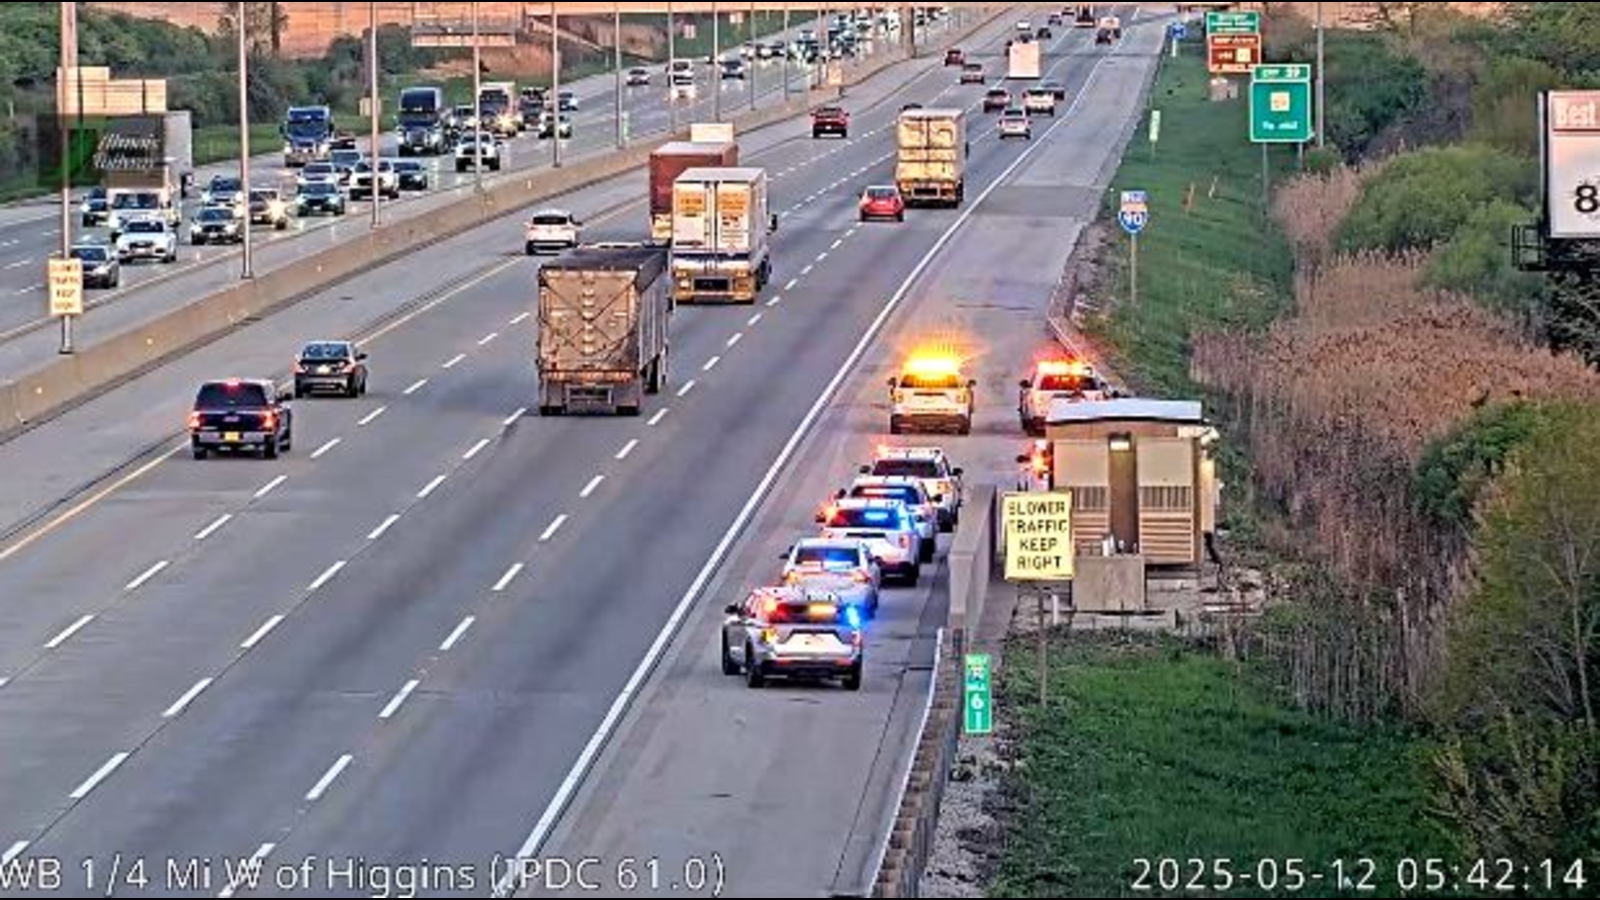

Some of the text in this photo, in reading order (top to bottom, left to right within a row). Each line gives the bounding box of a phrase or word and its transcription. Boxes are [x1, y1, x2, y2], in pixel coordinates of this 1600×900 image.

[1123, 213, 1143, 226] 90
[1008, 519, 1067, 534] TRAFFIC
[1019, 537, 1058, 551] KEEP
[1017, 555, 1062, 570] RIGHT
